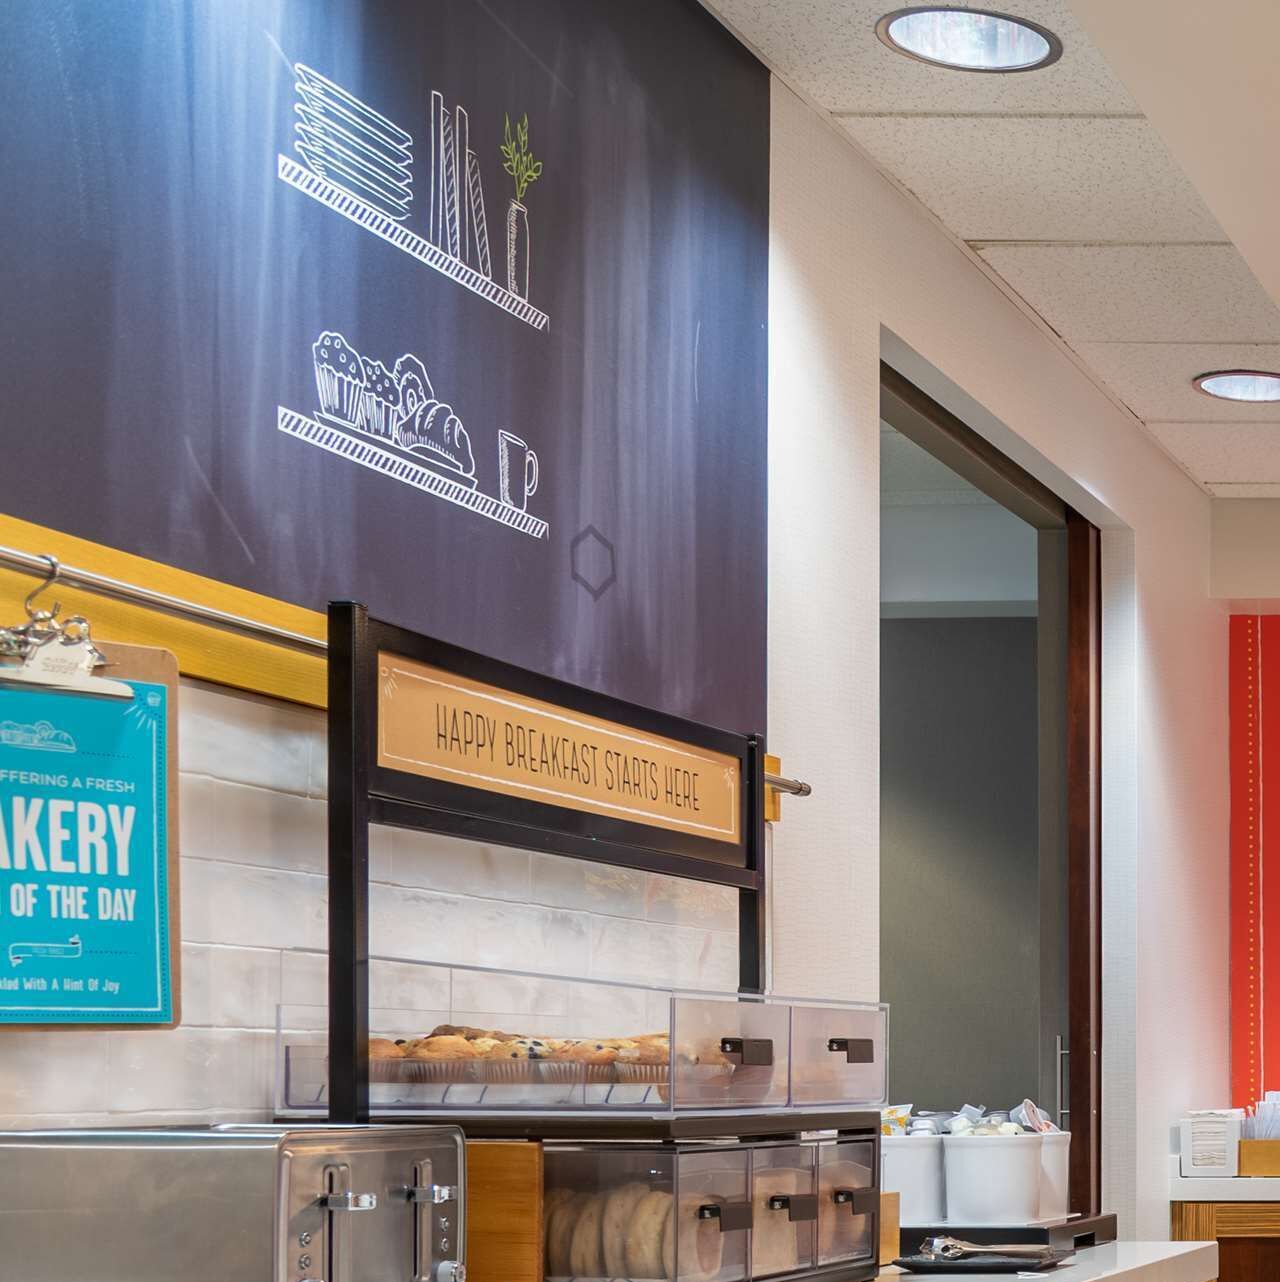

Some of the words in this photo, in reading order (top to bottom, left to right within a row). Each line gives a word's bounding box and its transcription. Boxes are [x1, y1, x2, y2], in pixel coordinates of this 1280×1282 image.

[436, 702, 497, 762] HAPPY
[505, 721, 599, 788] BREAKFAST
[605, 749, 659, 801] STARTS
[665, 765, 701, 812] HERE
[72, 777, 82, 788] A
[86, 777, 136, 793] FRESH
[10, 883, 38, 917] OF
[46, 884, 90, 919] THE
[97, 887, 136, 921] DAY
[23, 976, 48, 991] With
[51, 977, 60, 991] A
[88, 978, 99, 992] Of
[102, 979, 121, 995] Joy
